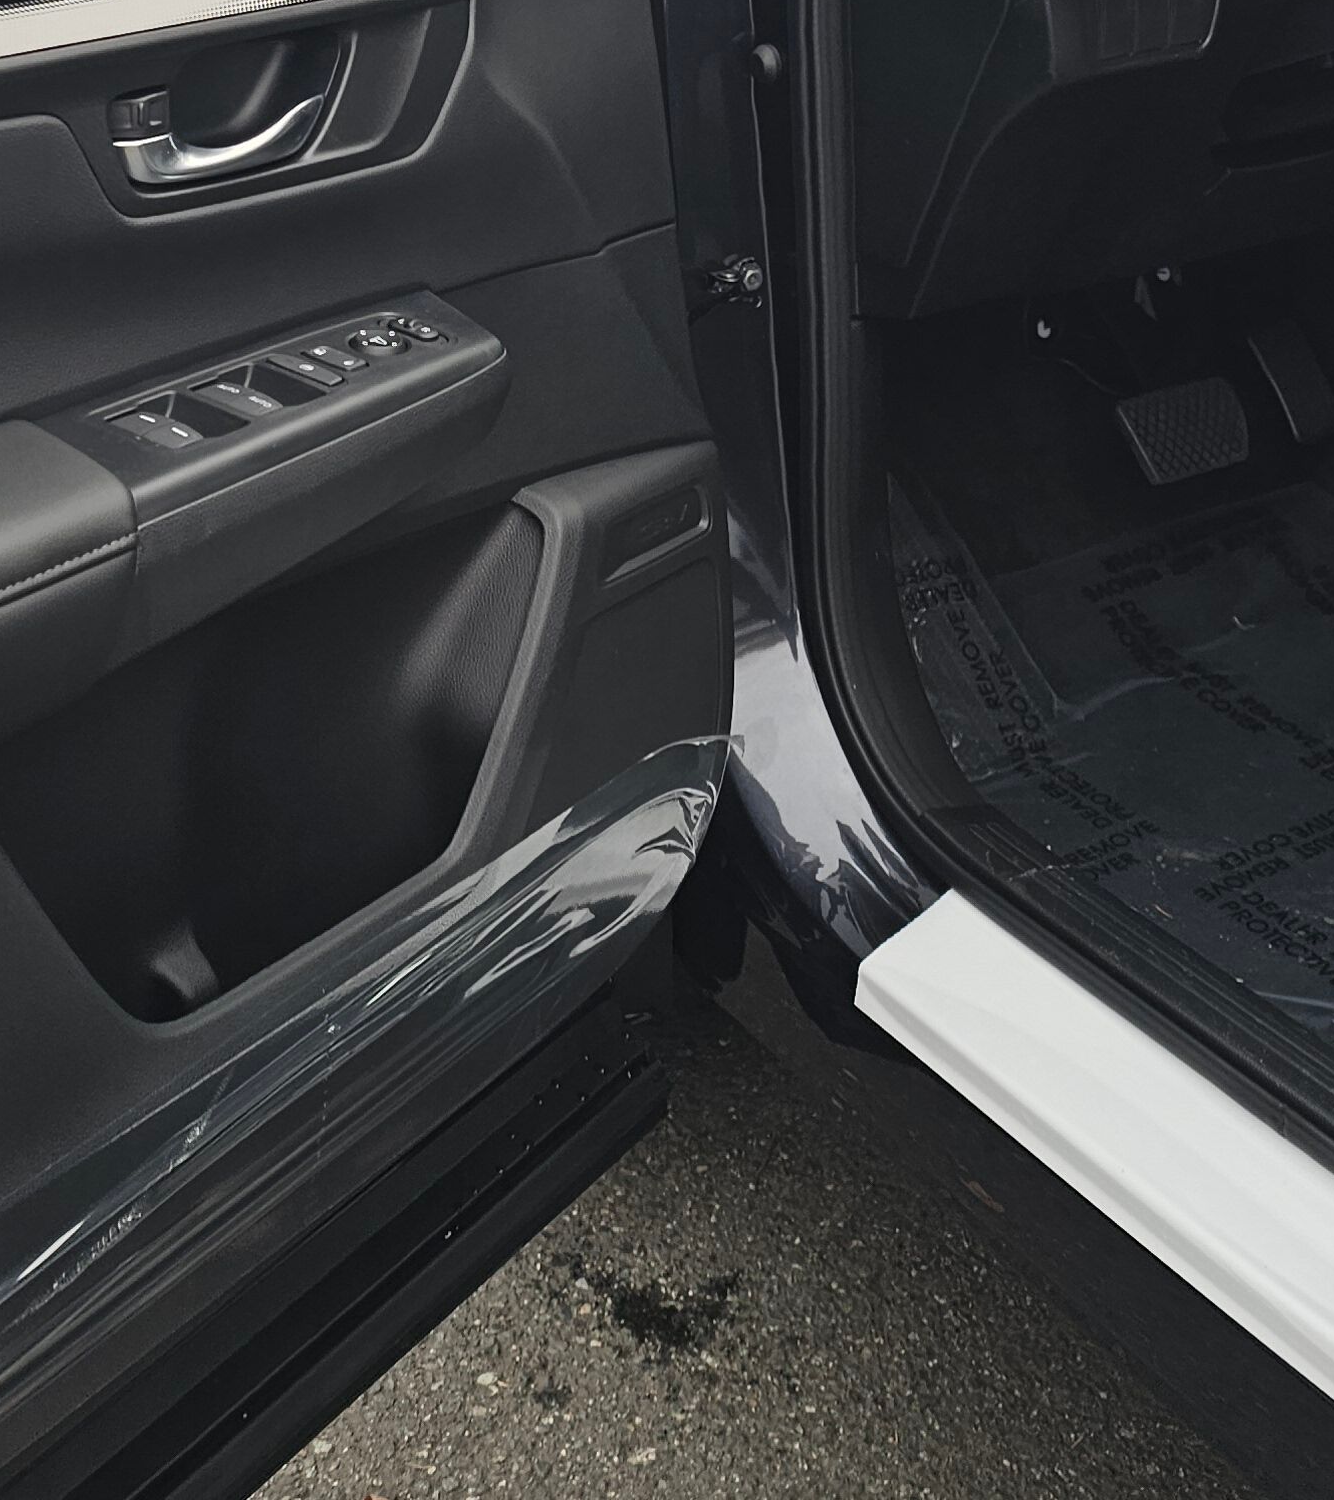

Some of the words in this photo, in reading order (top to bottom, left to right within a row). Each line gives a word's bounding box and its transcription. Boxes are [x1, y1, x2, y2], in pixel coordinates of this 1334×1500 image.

[248, 395, 272, 408] AUTO
[945, 607, 1003, 711] REMOVE
[989, 646, 1041, 734] COVER
[1193, 855, 1292, 903] REMOVE
[1240, 890, 1329, 947] DEALER
